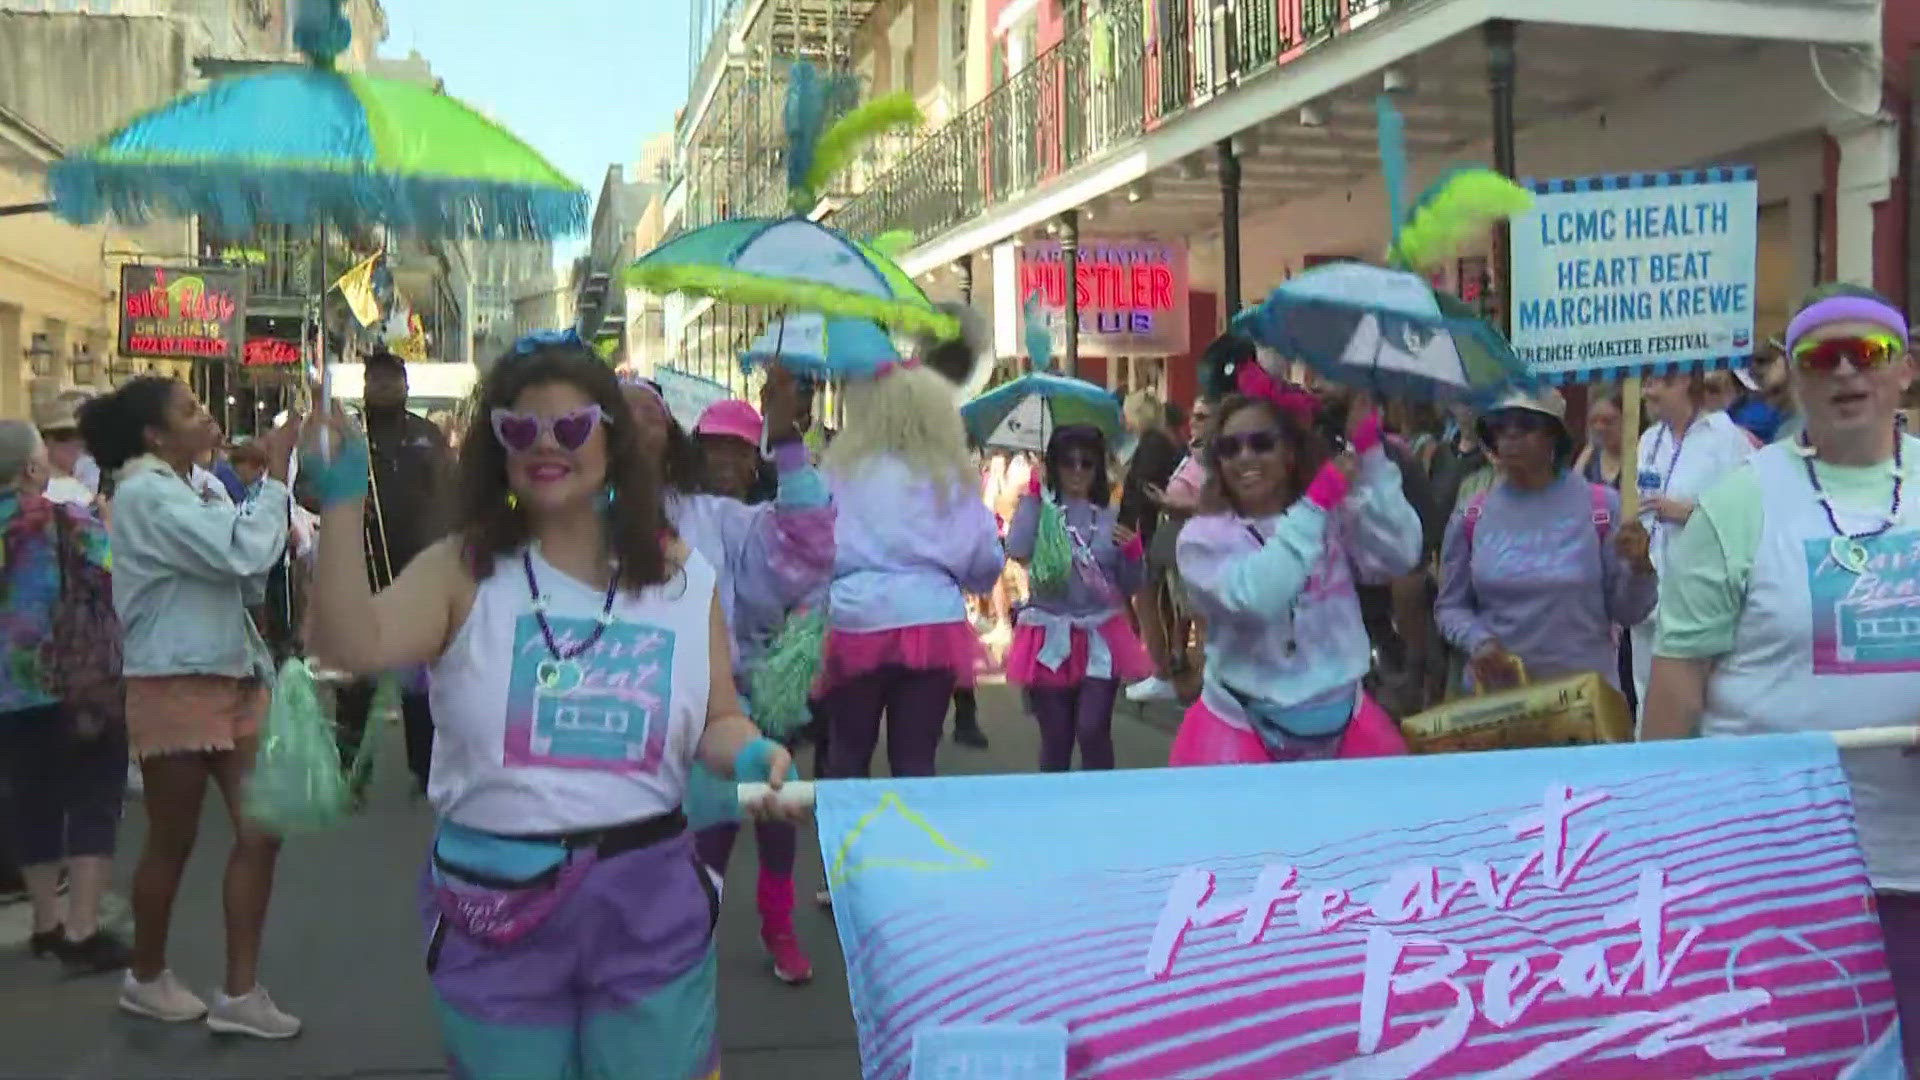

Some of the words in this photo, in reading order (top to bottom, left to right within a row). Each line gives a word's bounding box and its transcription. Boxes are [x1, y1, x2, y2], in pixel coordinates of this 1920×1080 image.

[1541, 206, 1617, 247] LCMC
[1625, 201, 1729, 239] HEALTH
[1020, 263, 1174, 311] HUSTLER
[1558, 255, 1643, 291] HEART
[1650, 250, 1712, 284] BEAT
[126, 288, 170, 319] BIG
[1519, 291, 1653, 331] MARCHING
[1659, 283, 1748, 321] KREWE
[1578, 337, 1644, 362] QUARTER
[1648, 333, 1710, 355] FESTIVAL
[1145, 784, 1611, 981] Heart
[1356, 866, 1706, 1056] Beat
